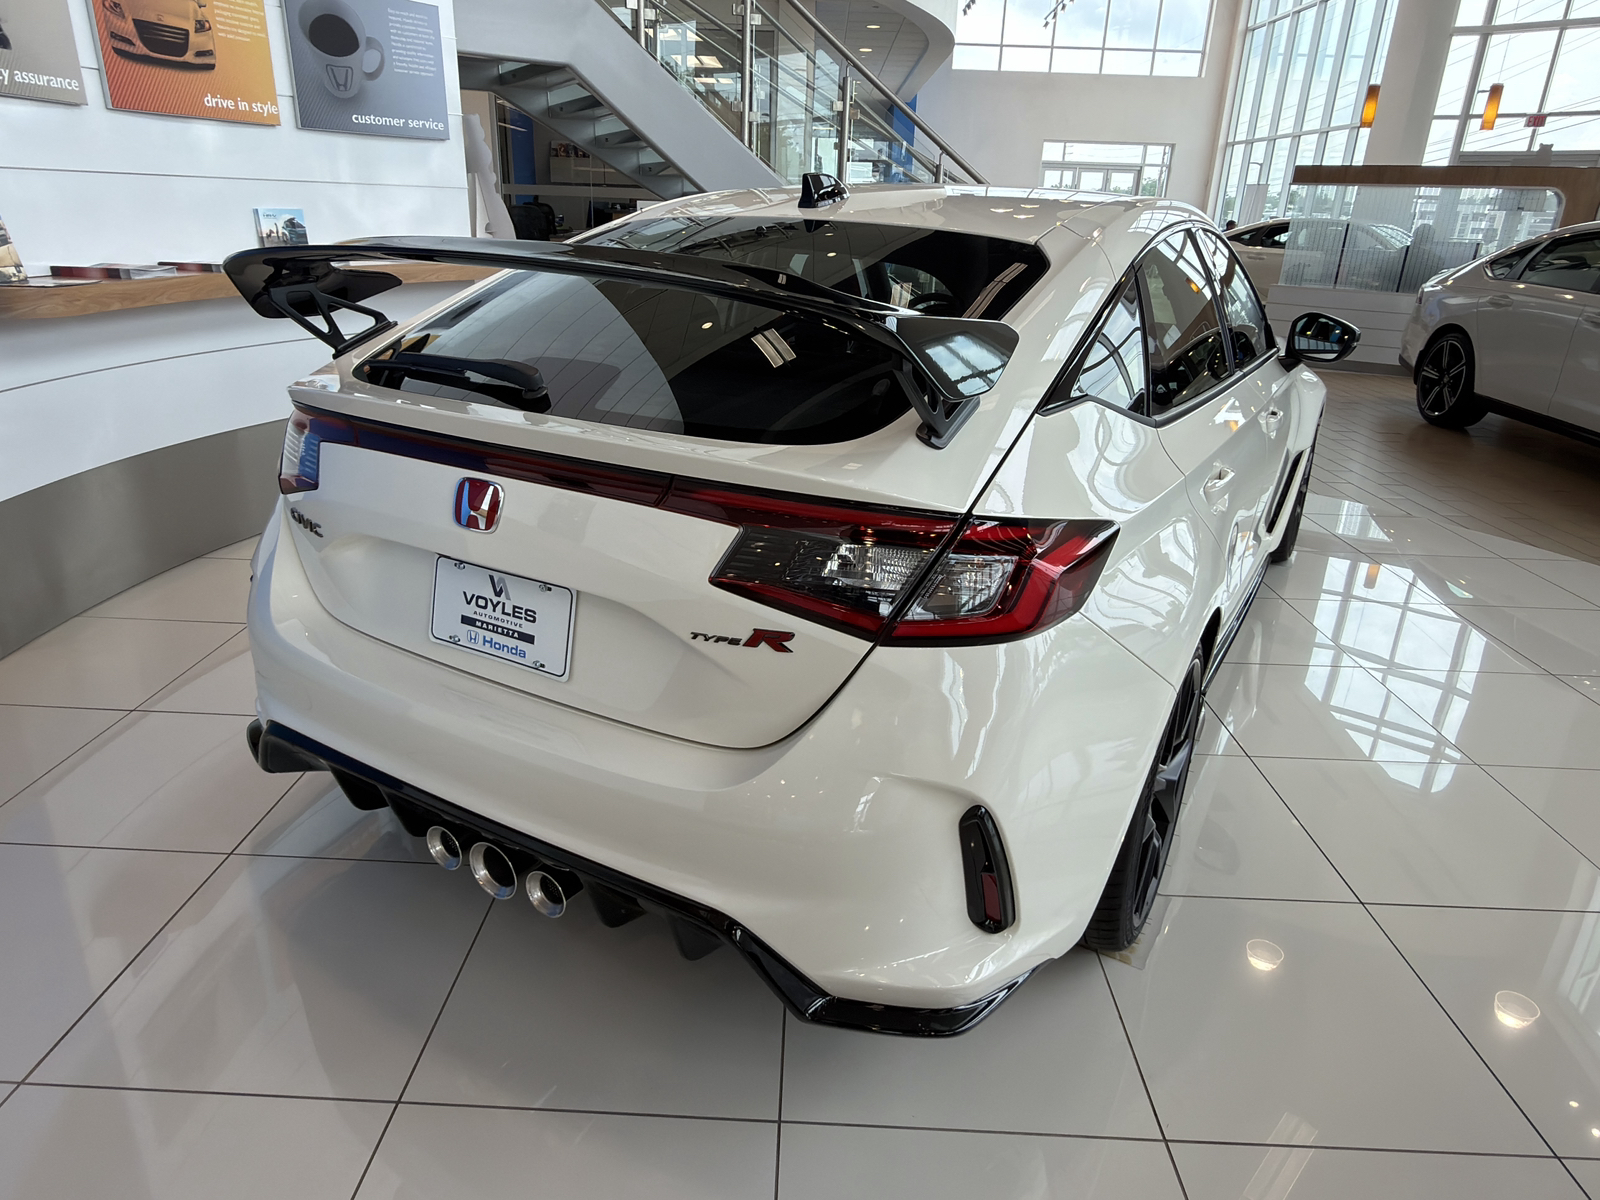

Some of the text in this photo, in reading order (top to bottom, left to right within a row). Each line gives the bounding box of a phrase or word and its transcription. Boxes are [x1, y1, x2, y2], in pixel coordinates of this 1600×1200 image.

[13, 70, 79, 91] assurance
[204, 93, 279, 117] drive in style
[352, 114, 445, 130] customer service
[290, 507, 324, 538] CIVIC
[463, 591, 537, 624] VOYLES
[473, 610, 524, 629] AUTOMOTIVE
[475, 620, 519, 638] MARIETTA
[690, 628, 796, 653] TYPE R
[482, 635, 527, 659] Honda
